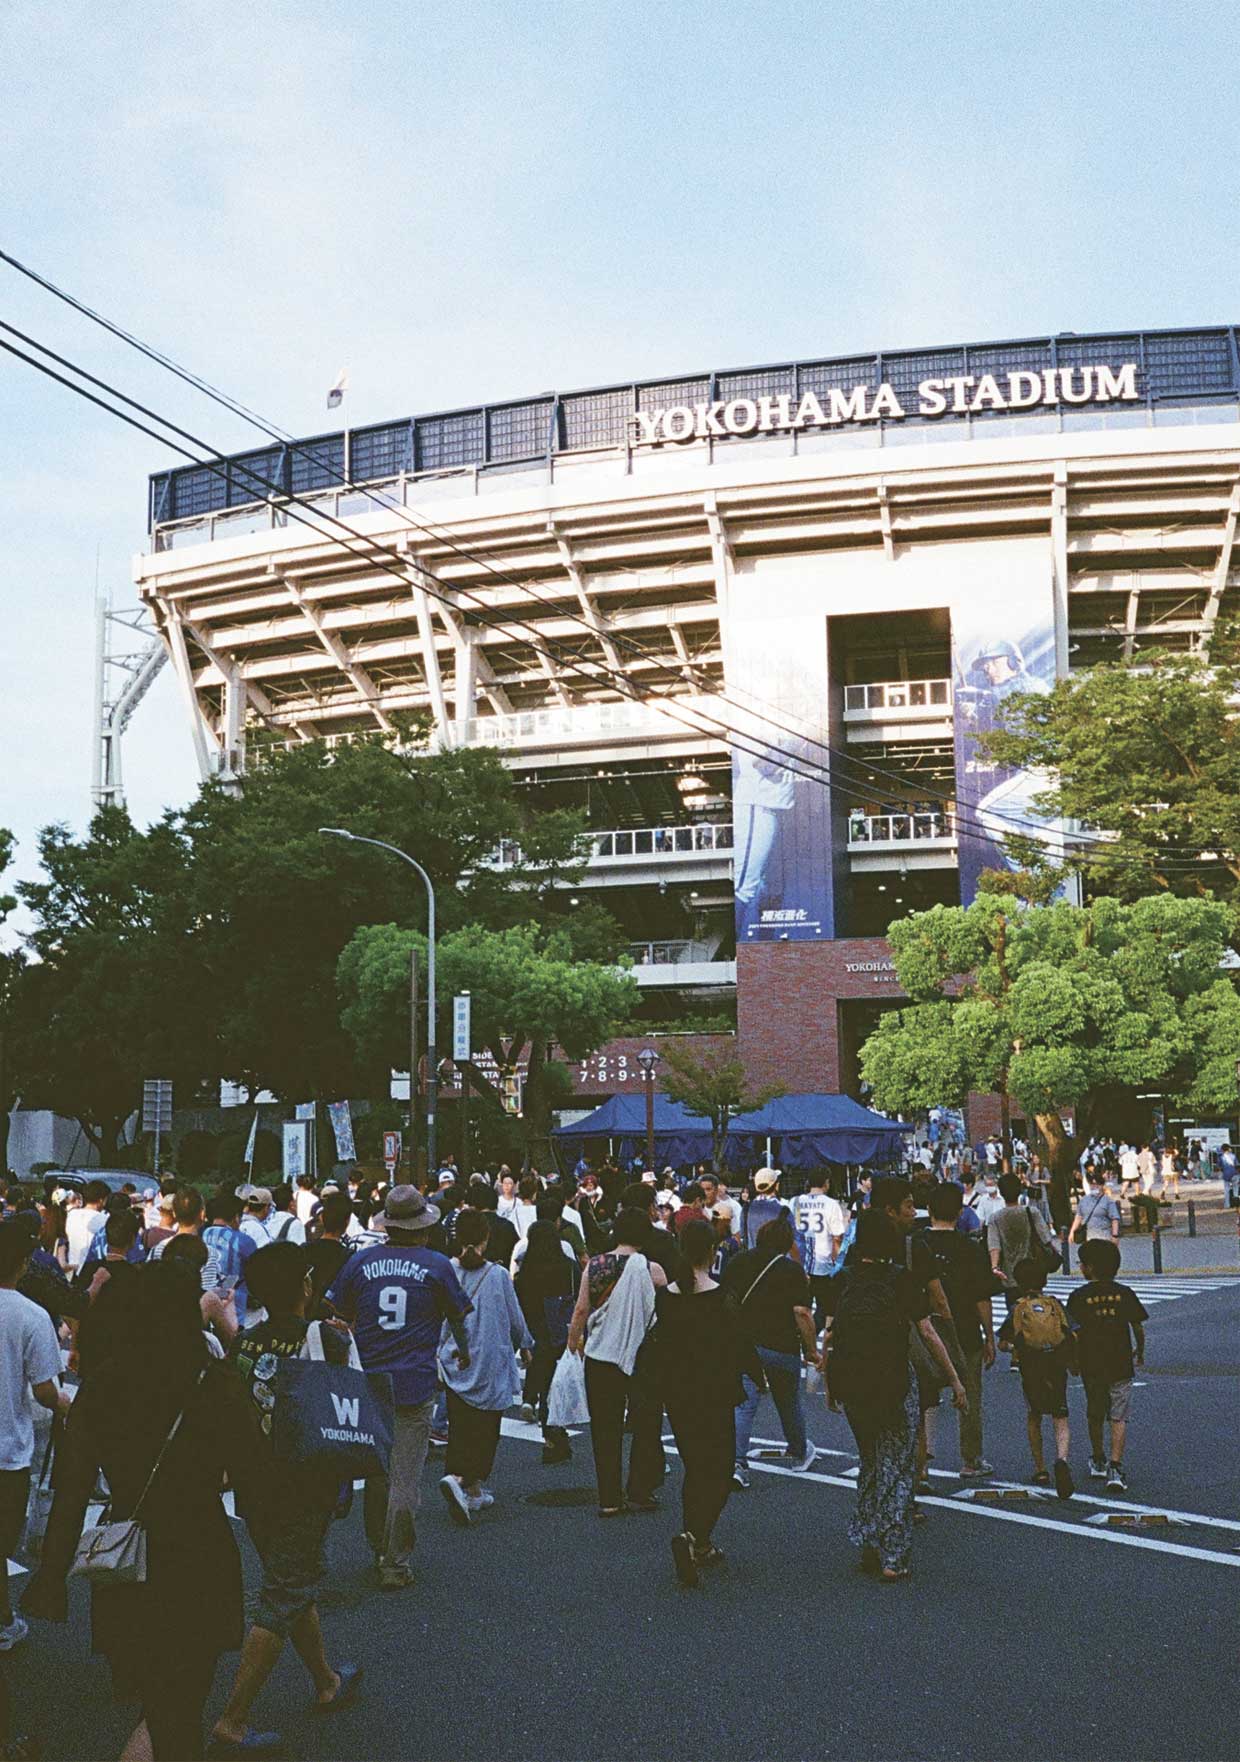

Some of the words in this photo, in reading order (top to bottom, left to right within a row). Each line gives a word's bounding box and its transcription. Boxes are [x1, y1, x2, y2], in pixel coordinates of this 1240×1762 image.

[633, 383, 905, 446] YOKOHAMA
[918, 363, 1139, 414] STADIUM
[845, 962, 897, 972] YOKOHAM
[799, 1212, 825, 1234] 53
[362, 1258, 429, 1283] YOKOHAMA
[378, 1286, 407, 1330] 9
[330, 1392, 359, 1428] W
[320, 1427, 376, 1446] YOKOHAMA
